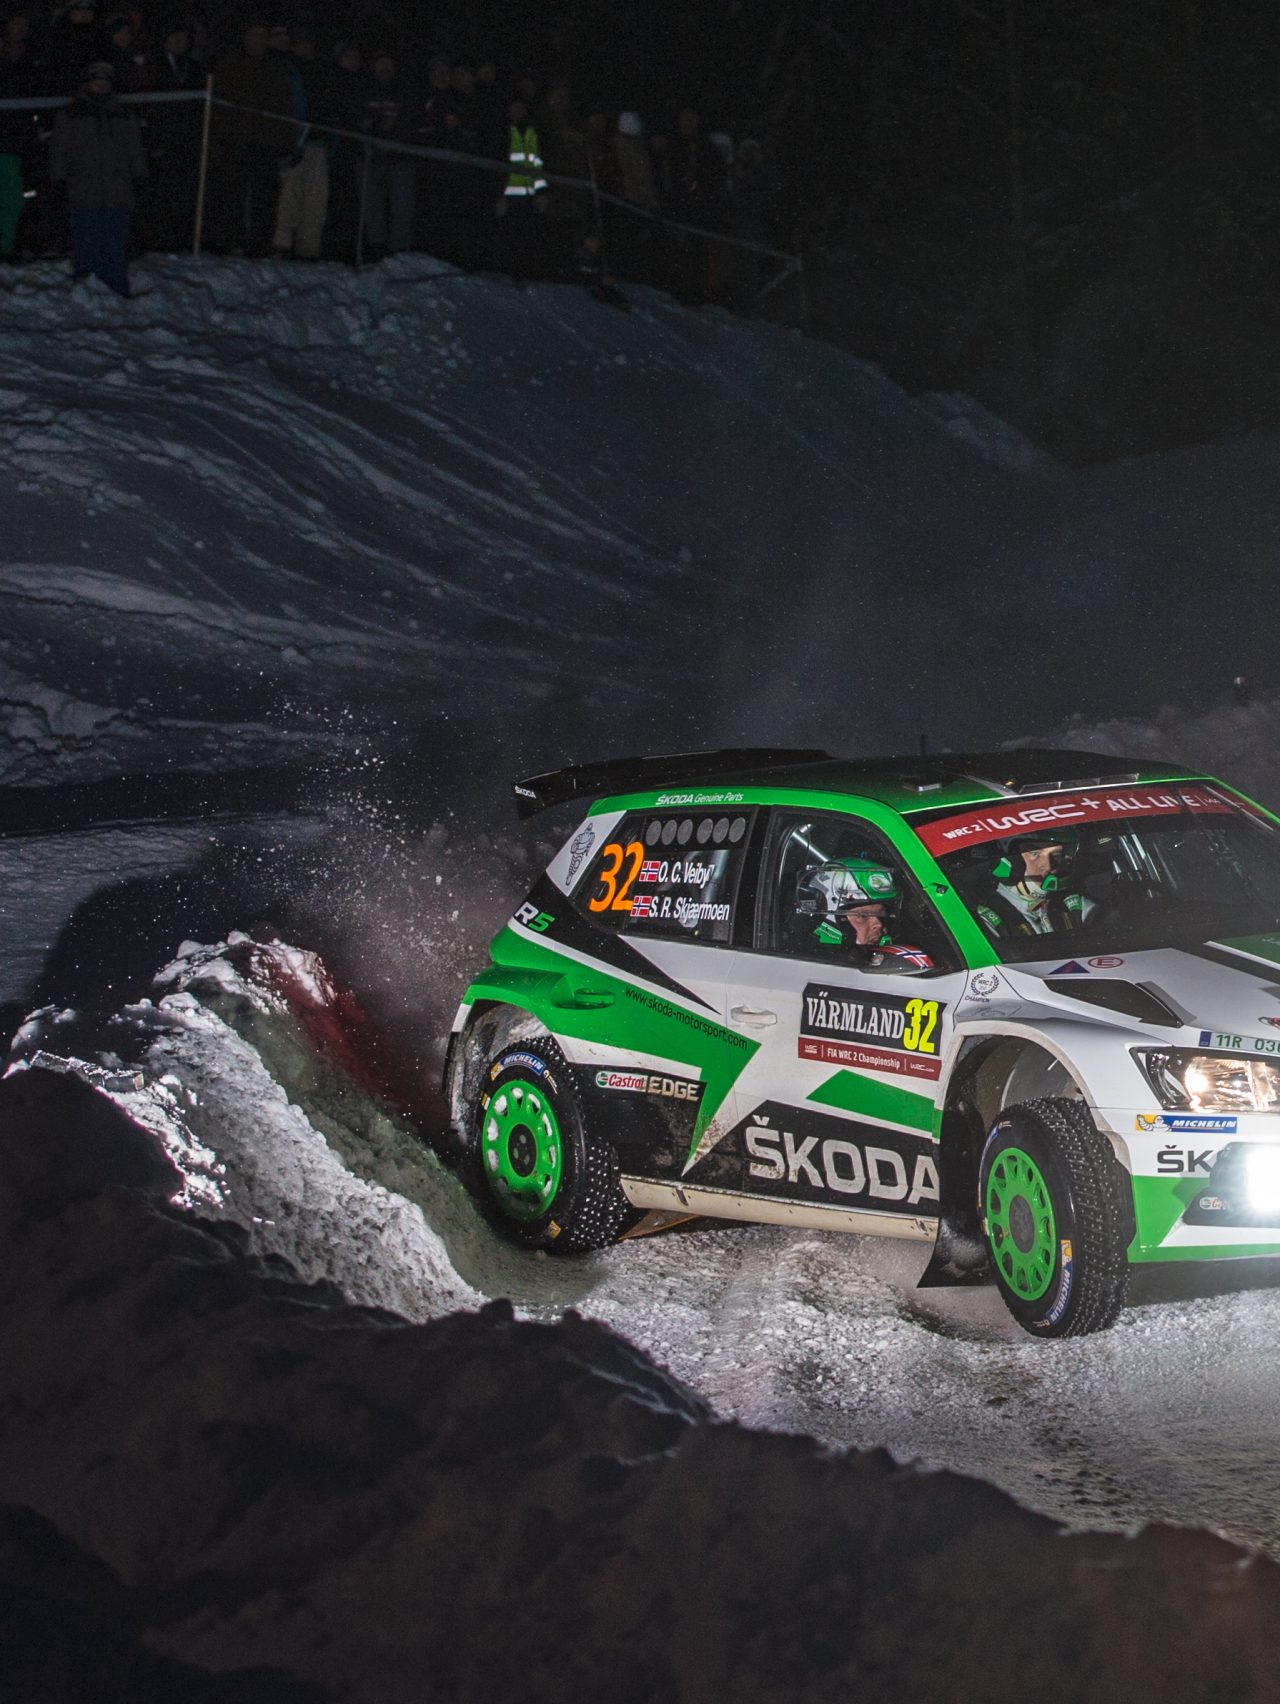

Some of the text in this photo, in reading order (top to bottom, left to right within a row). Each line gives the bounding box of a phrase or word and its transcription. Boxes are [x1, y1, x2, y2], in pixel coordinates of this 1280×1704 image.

[656, 792, 744, 805] ŠKODA Genuine Parts
[1108, 796, 1151, 812] ALL
[942, 824, 983, 839] WRC 2
[589, 841, 644, 912] 32
[658, 861, 711, 889] O. C. Veiby
[514, 901, 555, 932] R5
[649, 896, 730, 922] S. R. Skjærmoen
[625, 986, 748, 1051] www.skoda-motorsport.com
[806, 991, 939, 1053] VÄRMLAND 32
[1216, 1034, 1242, 1048] 11R
[503, 1055, 544, 1071] MICHELIN
[827, 1048, 900, 1070] FIA WRC 2 Championship
[607, 1073, 700, 1101] Castrol EDGE
[1172, 1119, 1237, 1129] MICHELIN
[746, 1115, 940, 1205] ŠKODA
[1050, 1269, 1071, 1323] MICHELIN
